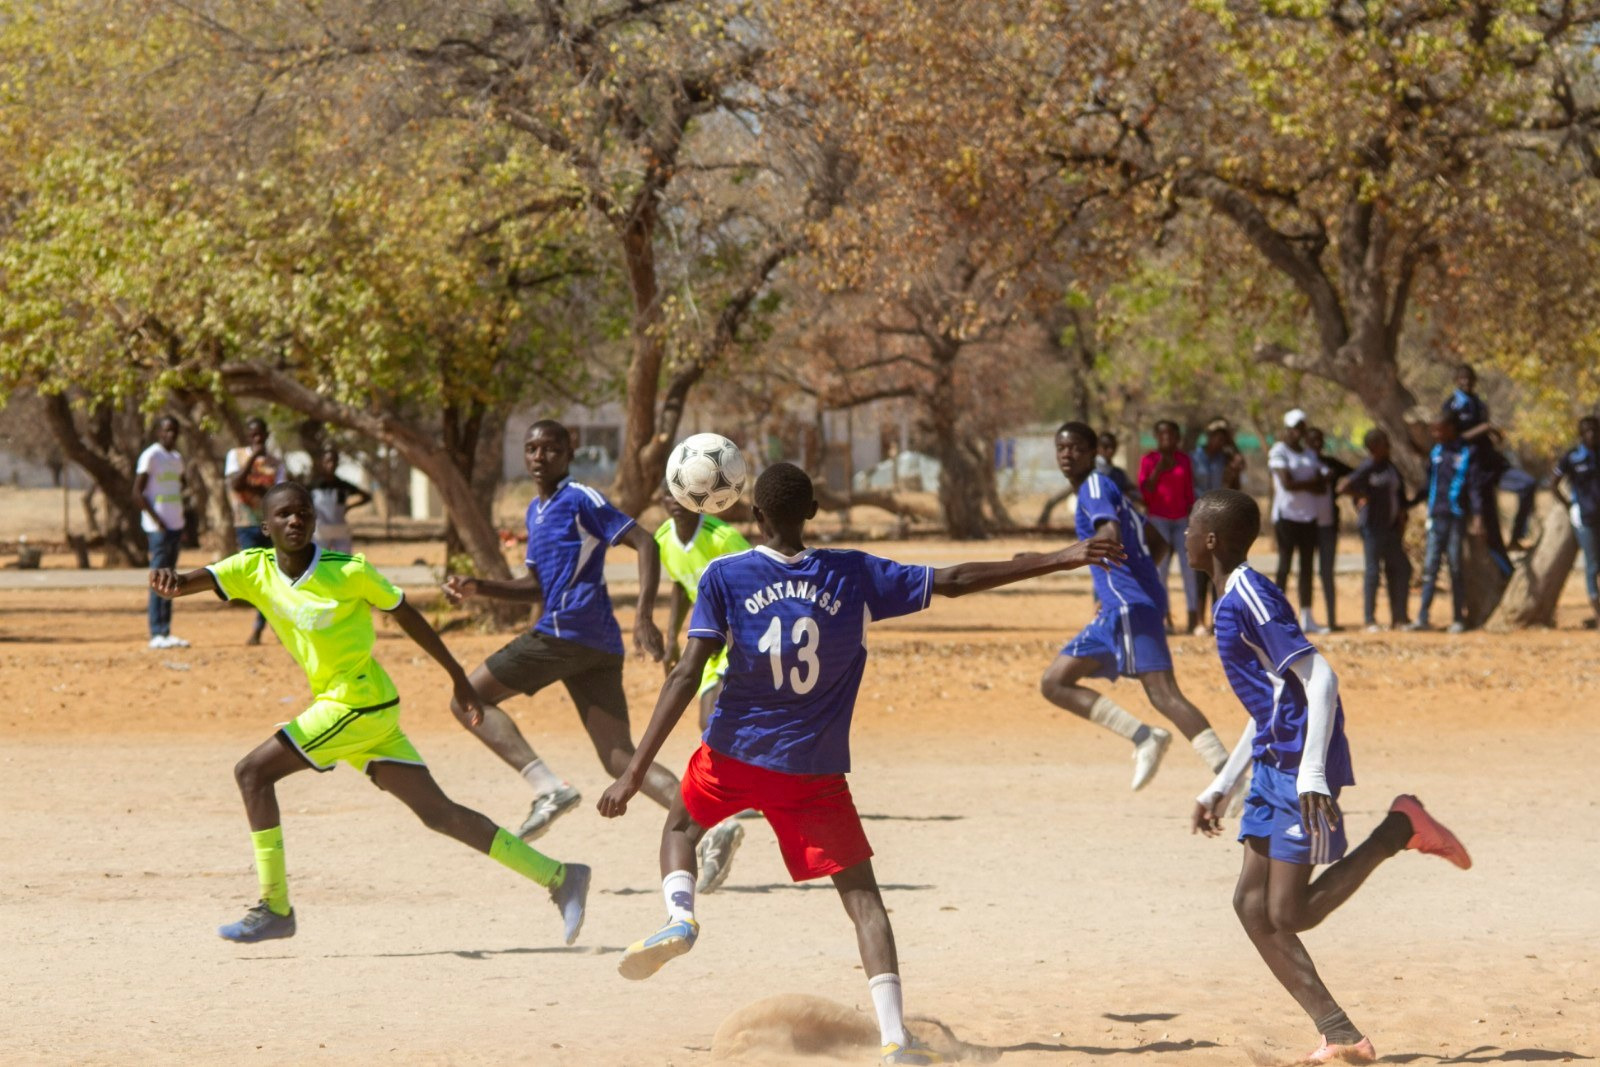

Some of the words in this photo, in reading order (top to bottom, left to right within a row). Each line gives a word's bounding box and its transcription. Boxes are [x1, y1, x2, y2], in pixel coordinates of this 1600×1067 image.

[745, 580, 817, 614] OKATANA
[819, 592, 841, 615] S.S
[758, 616, 820, 695] 13
